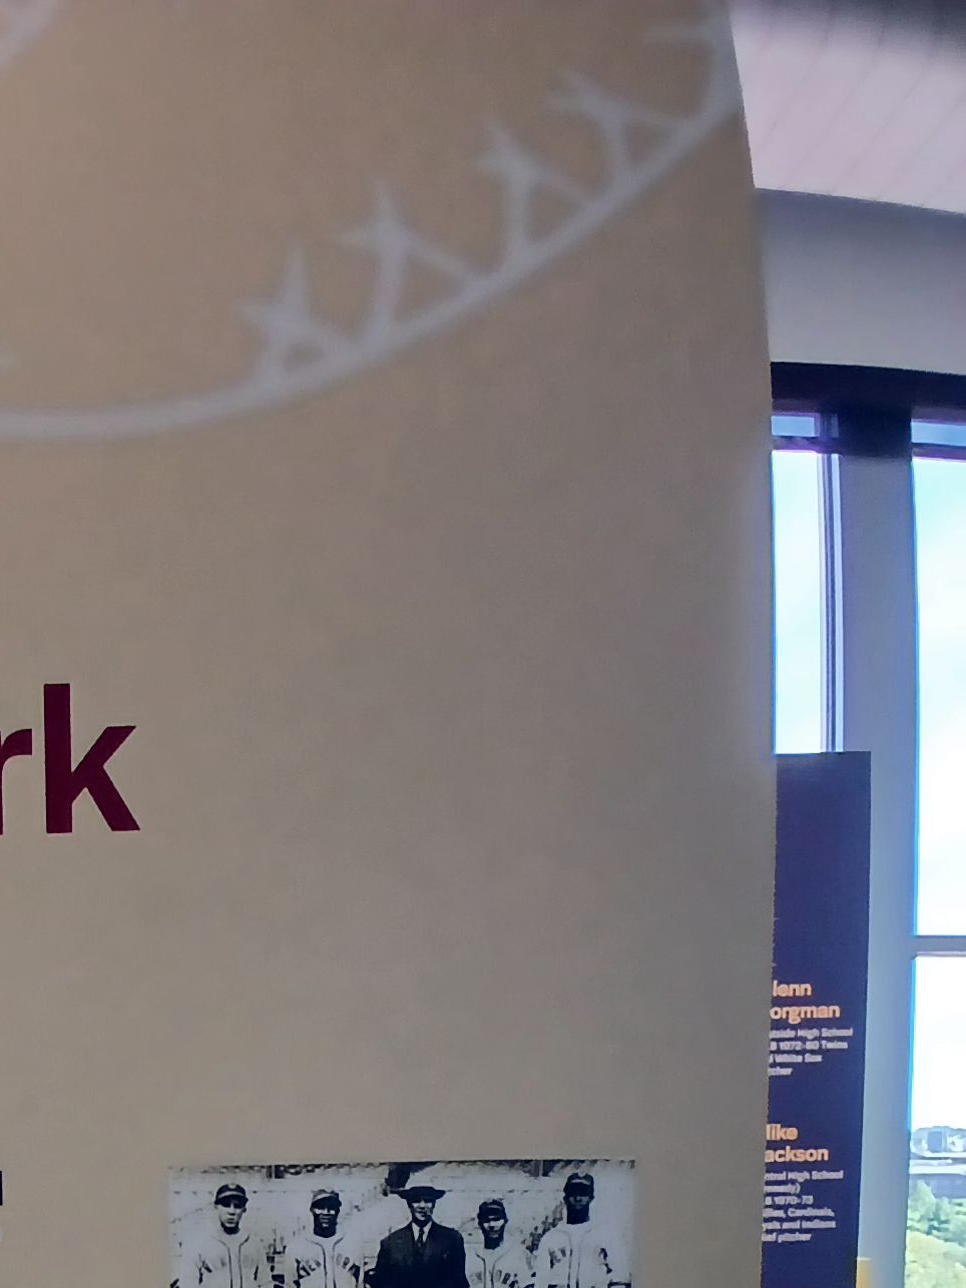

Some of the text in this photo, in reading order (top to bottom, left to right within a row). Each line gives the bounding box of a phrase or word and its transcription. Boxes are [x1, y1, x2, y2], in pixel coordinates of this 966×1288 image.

[772, 980, 812, 997] lenn
[769, 1004, 841, 1024] orgman
[764, 1146, 829, 1163] ackson
